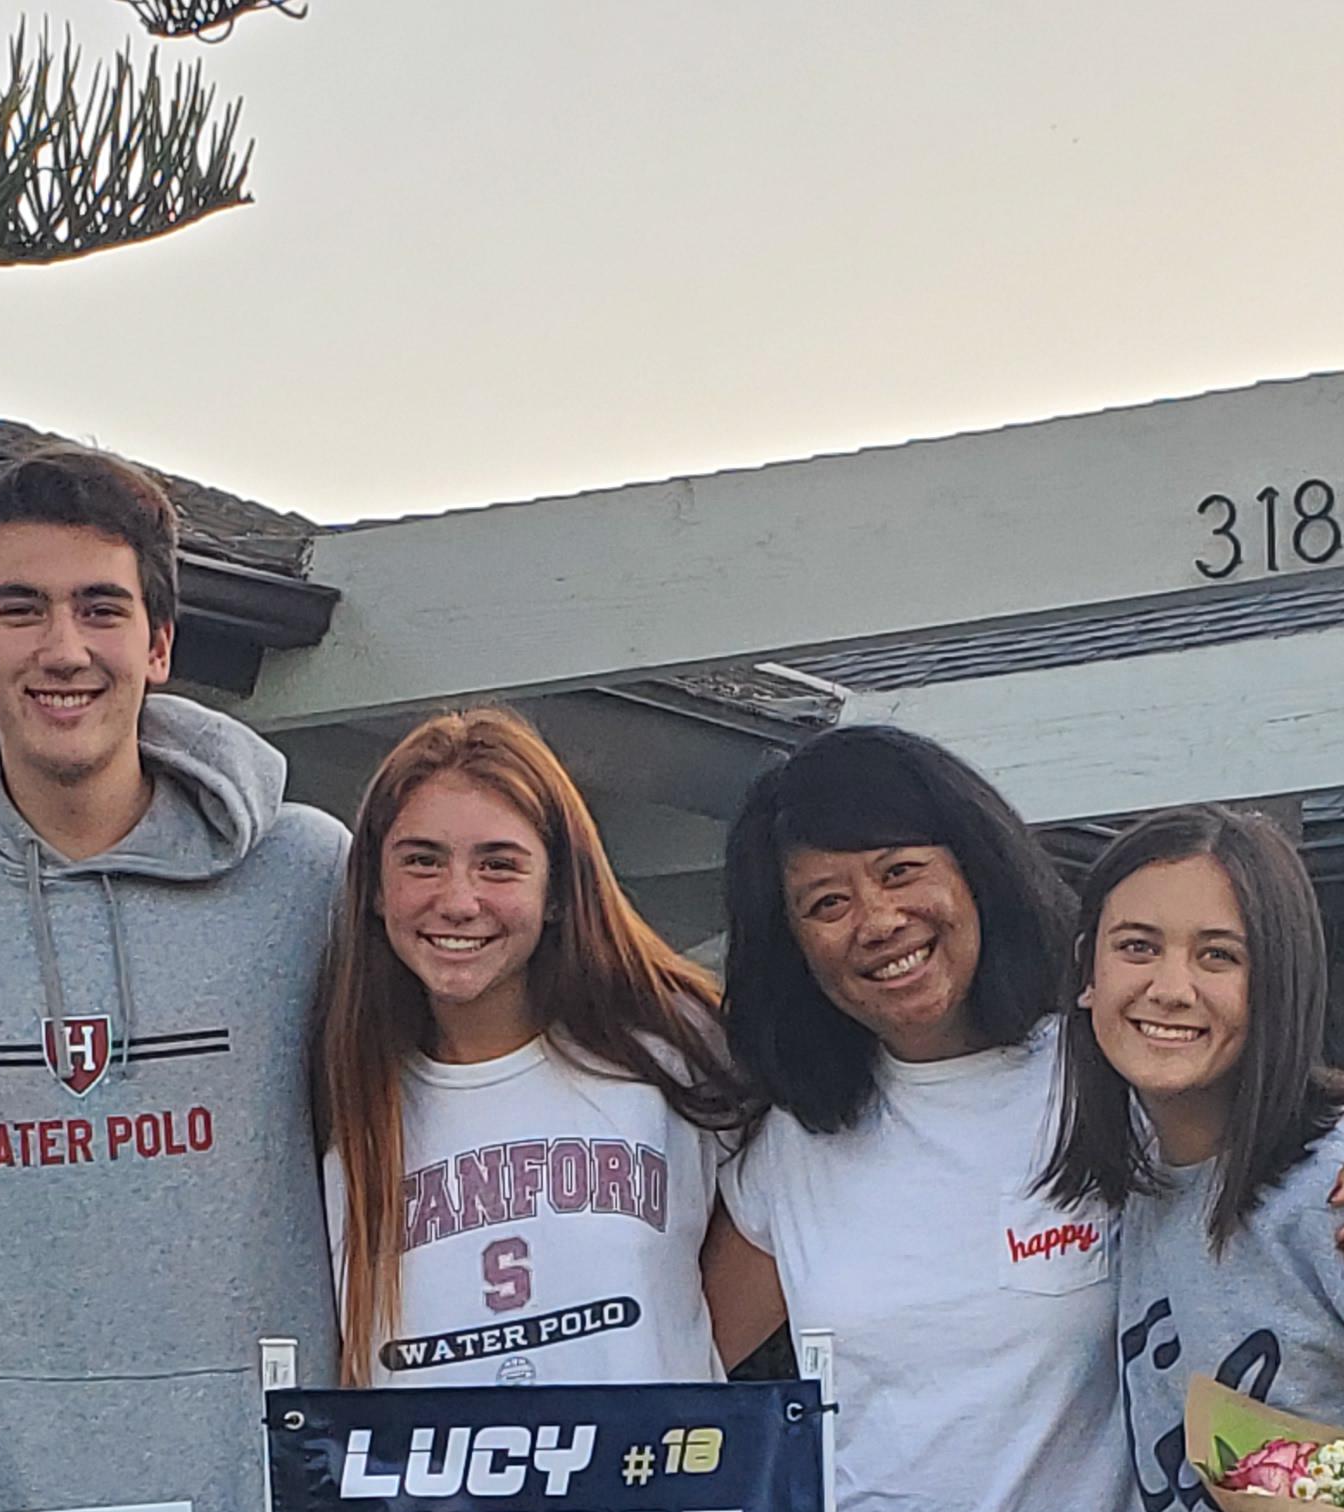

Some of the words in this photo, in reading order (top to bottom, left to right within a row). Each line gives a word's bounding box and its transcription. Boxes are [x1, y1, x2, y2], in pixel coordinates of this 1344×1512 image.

[107, 1107, 213, 1160] POLO
[401, 1137, 668, 1252] ANFORD
[482, 1236, 532, 1313] S
[1007, 1223, 1099, 1263] happy
[397, 1325, 528, 1366] WATER
[540, 1303, 624, 1339] POLO
[340, 1425, 597, 1499] LUCY
[622, 1427, 724, 1486] #18
